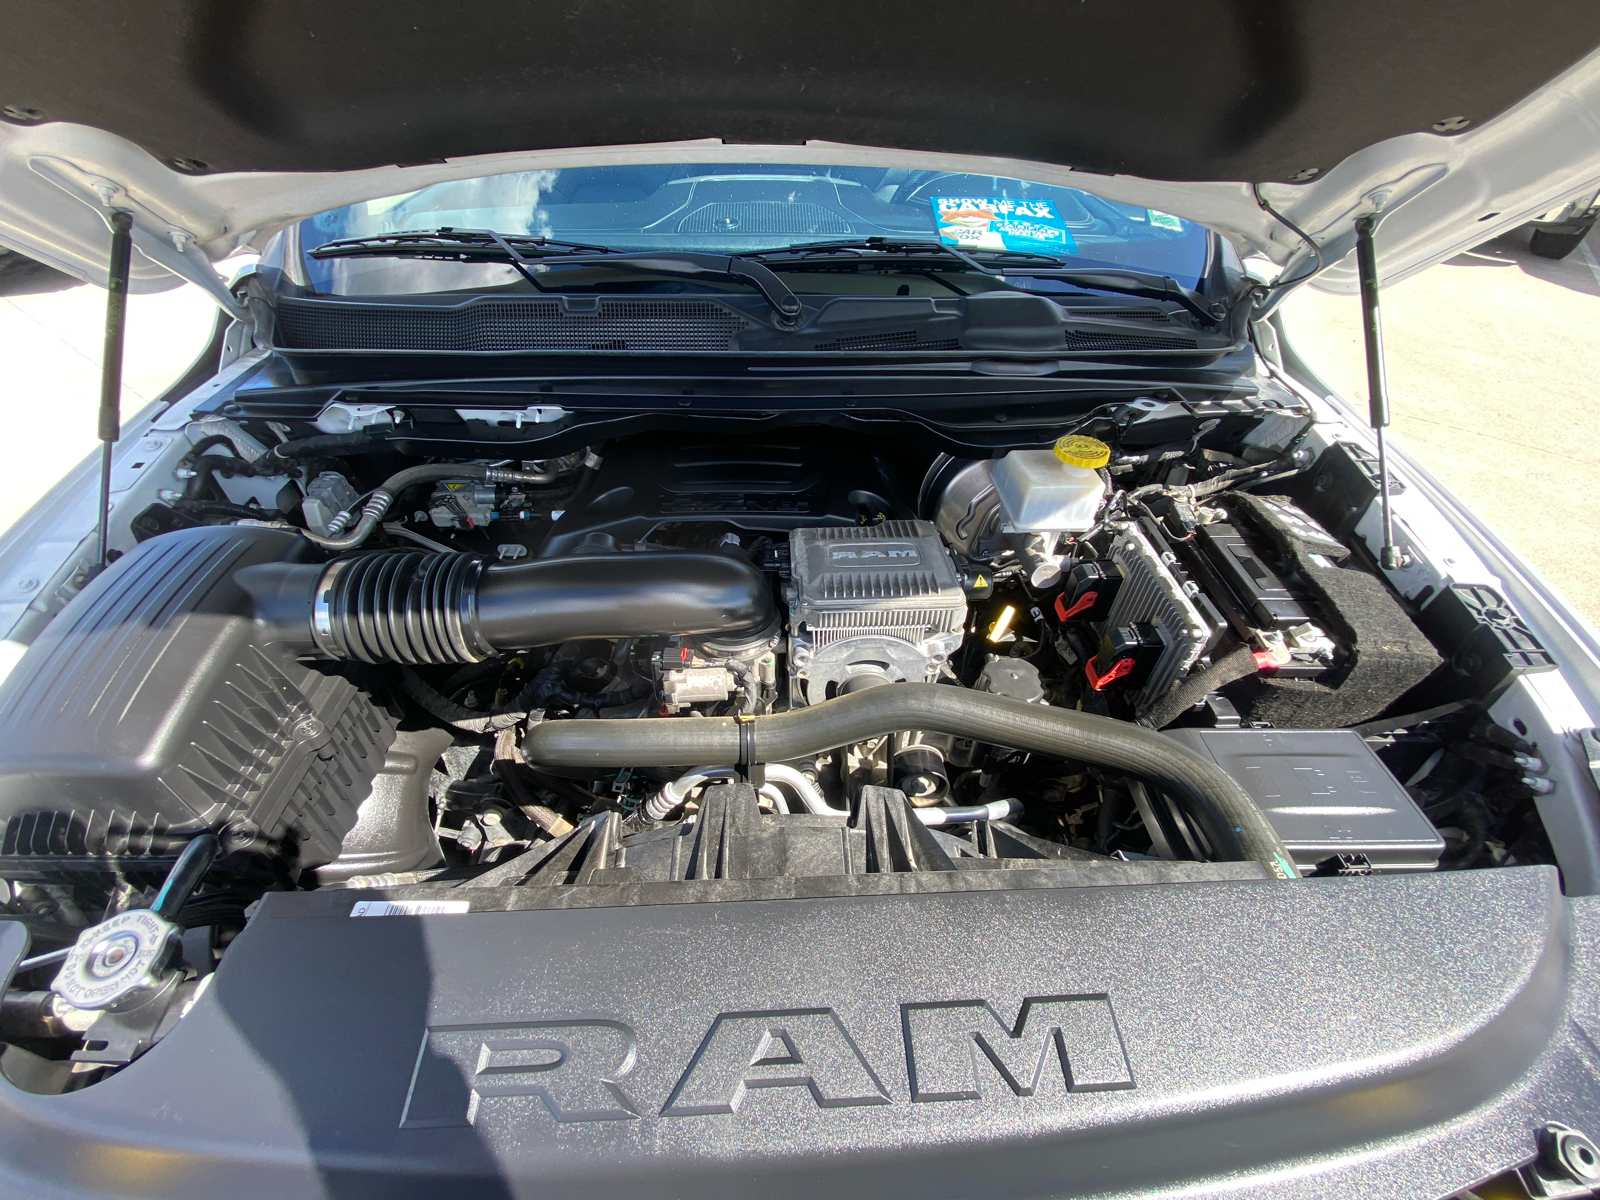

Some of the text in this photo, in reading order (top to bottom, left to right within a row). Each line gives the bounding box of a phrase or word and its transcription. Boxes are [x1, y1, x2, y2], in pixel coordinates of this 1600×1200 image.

[938, 202, 1056, 219] CARFAX
[993, 199, 1017, 207] ME
[1019, 201, 1049, 209] THE
[954, 228, 983, 236] CAR
[831, 549, 918, 559] RAM
[92, 914, 160, 938] KEEP TIGHT
[65, 980, 86, 997] NOT
[120, 959, 146, 983] HOT
[400, 992, 1137, 1128] RAM
